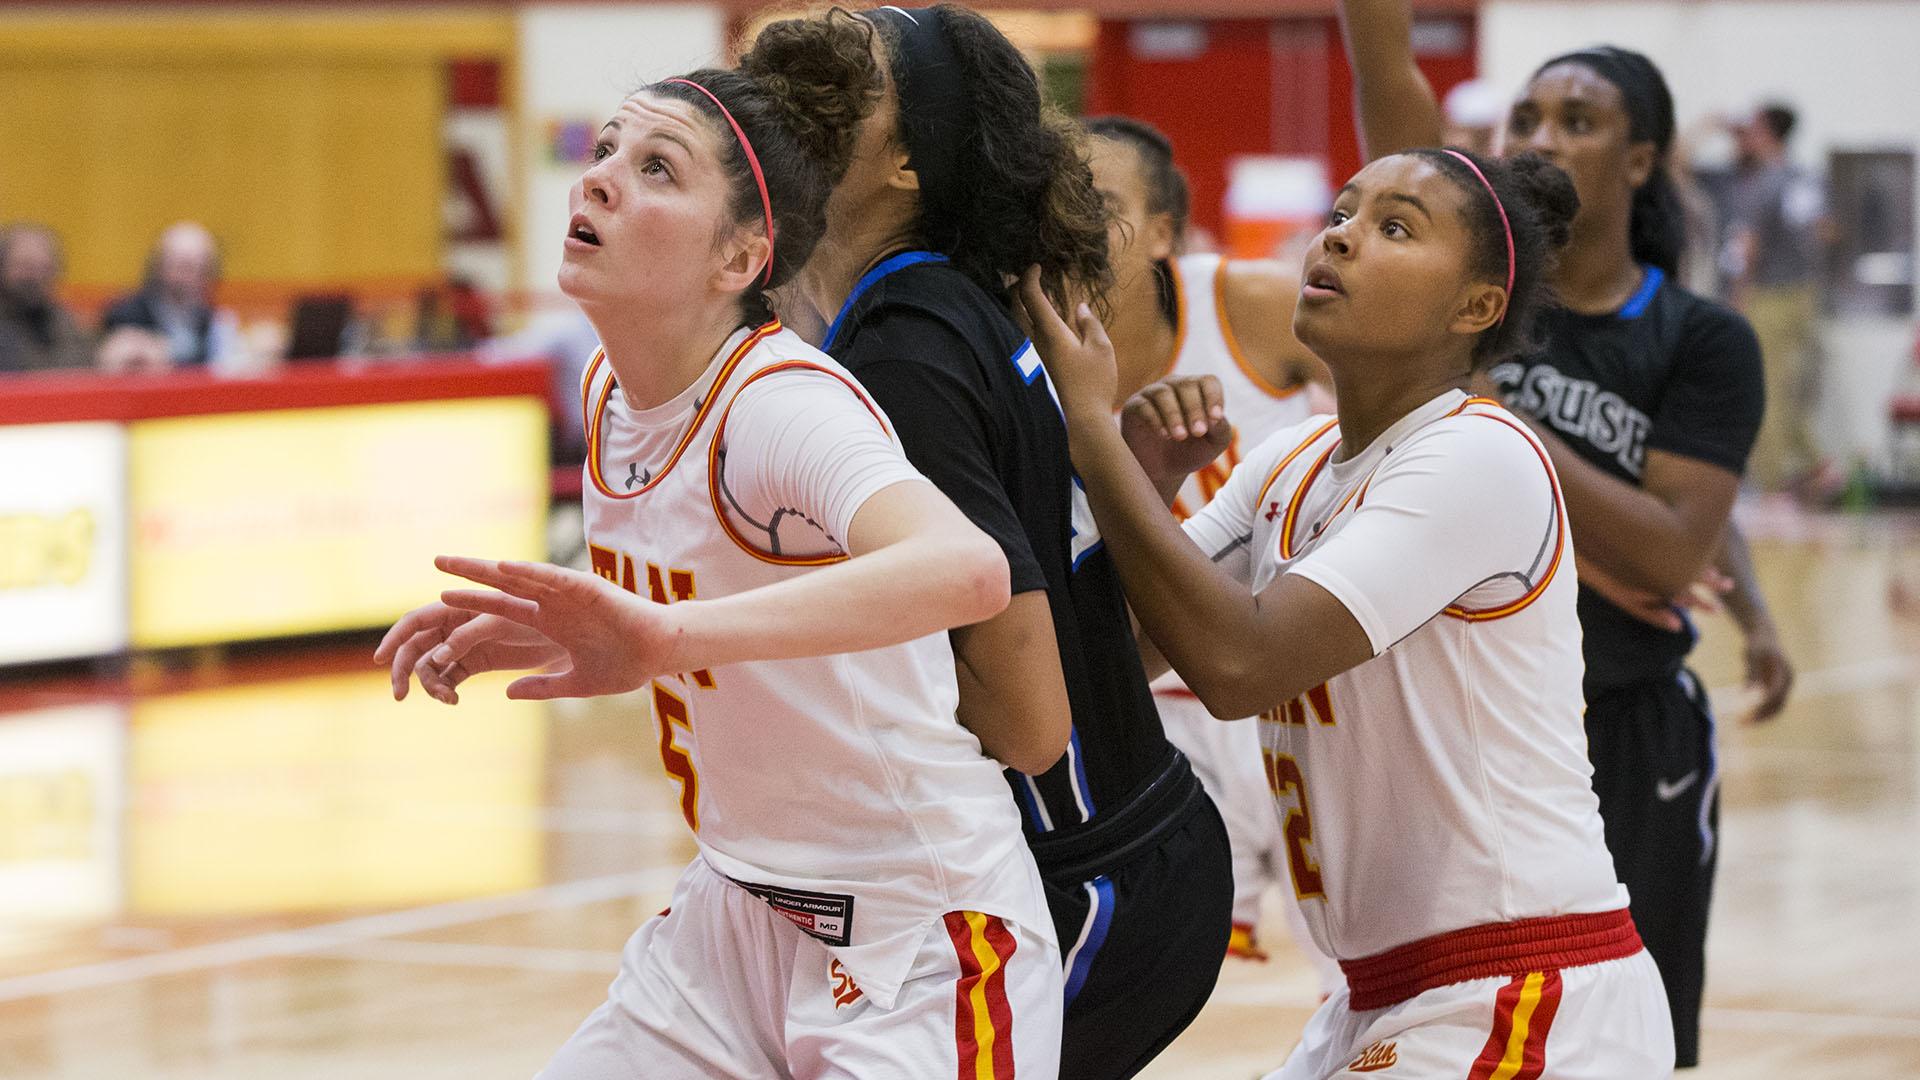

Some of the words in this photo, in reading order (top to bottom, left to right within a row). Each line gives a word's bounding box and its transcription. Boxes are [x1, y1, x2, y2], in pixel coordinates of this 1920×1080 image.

[651, 679, 700, 834] 5
[775, 896, 801, 907] UNDER
[802, 903, 842, 913] ARMOUR
[777, 908, 813, 926] AUTHENTIC
[819, 921, 839, 932] MD
